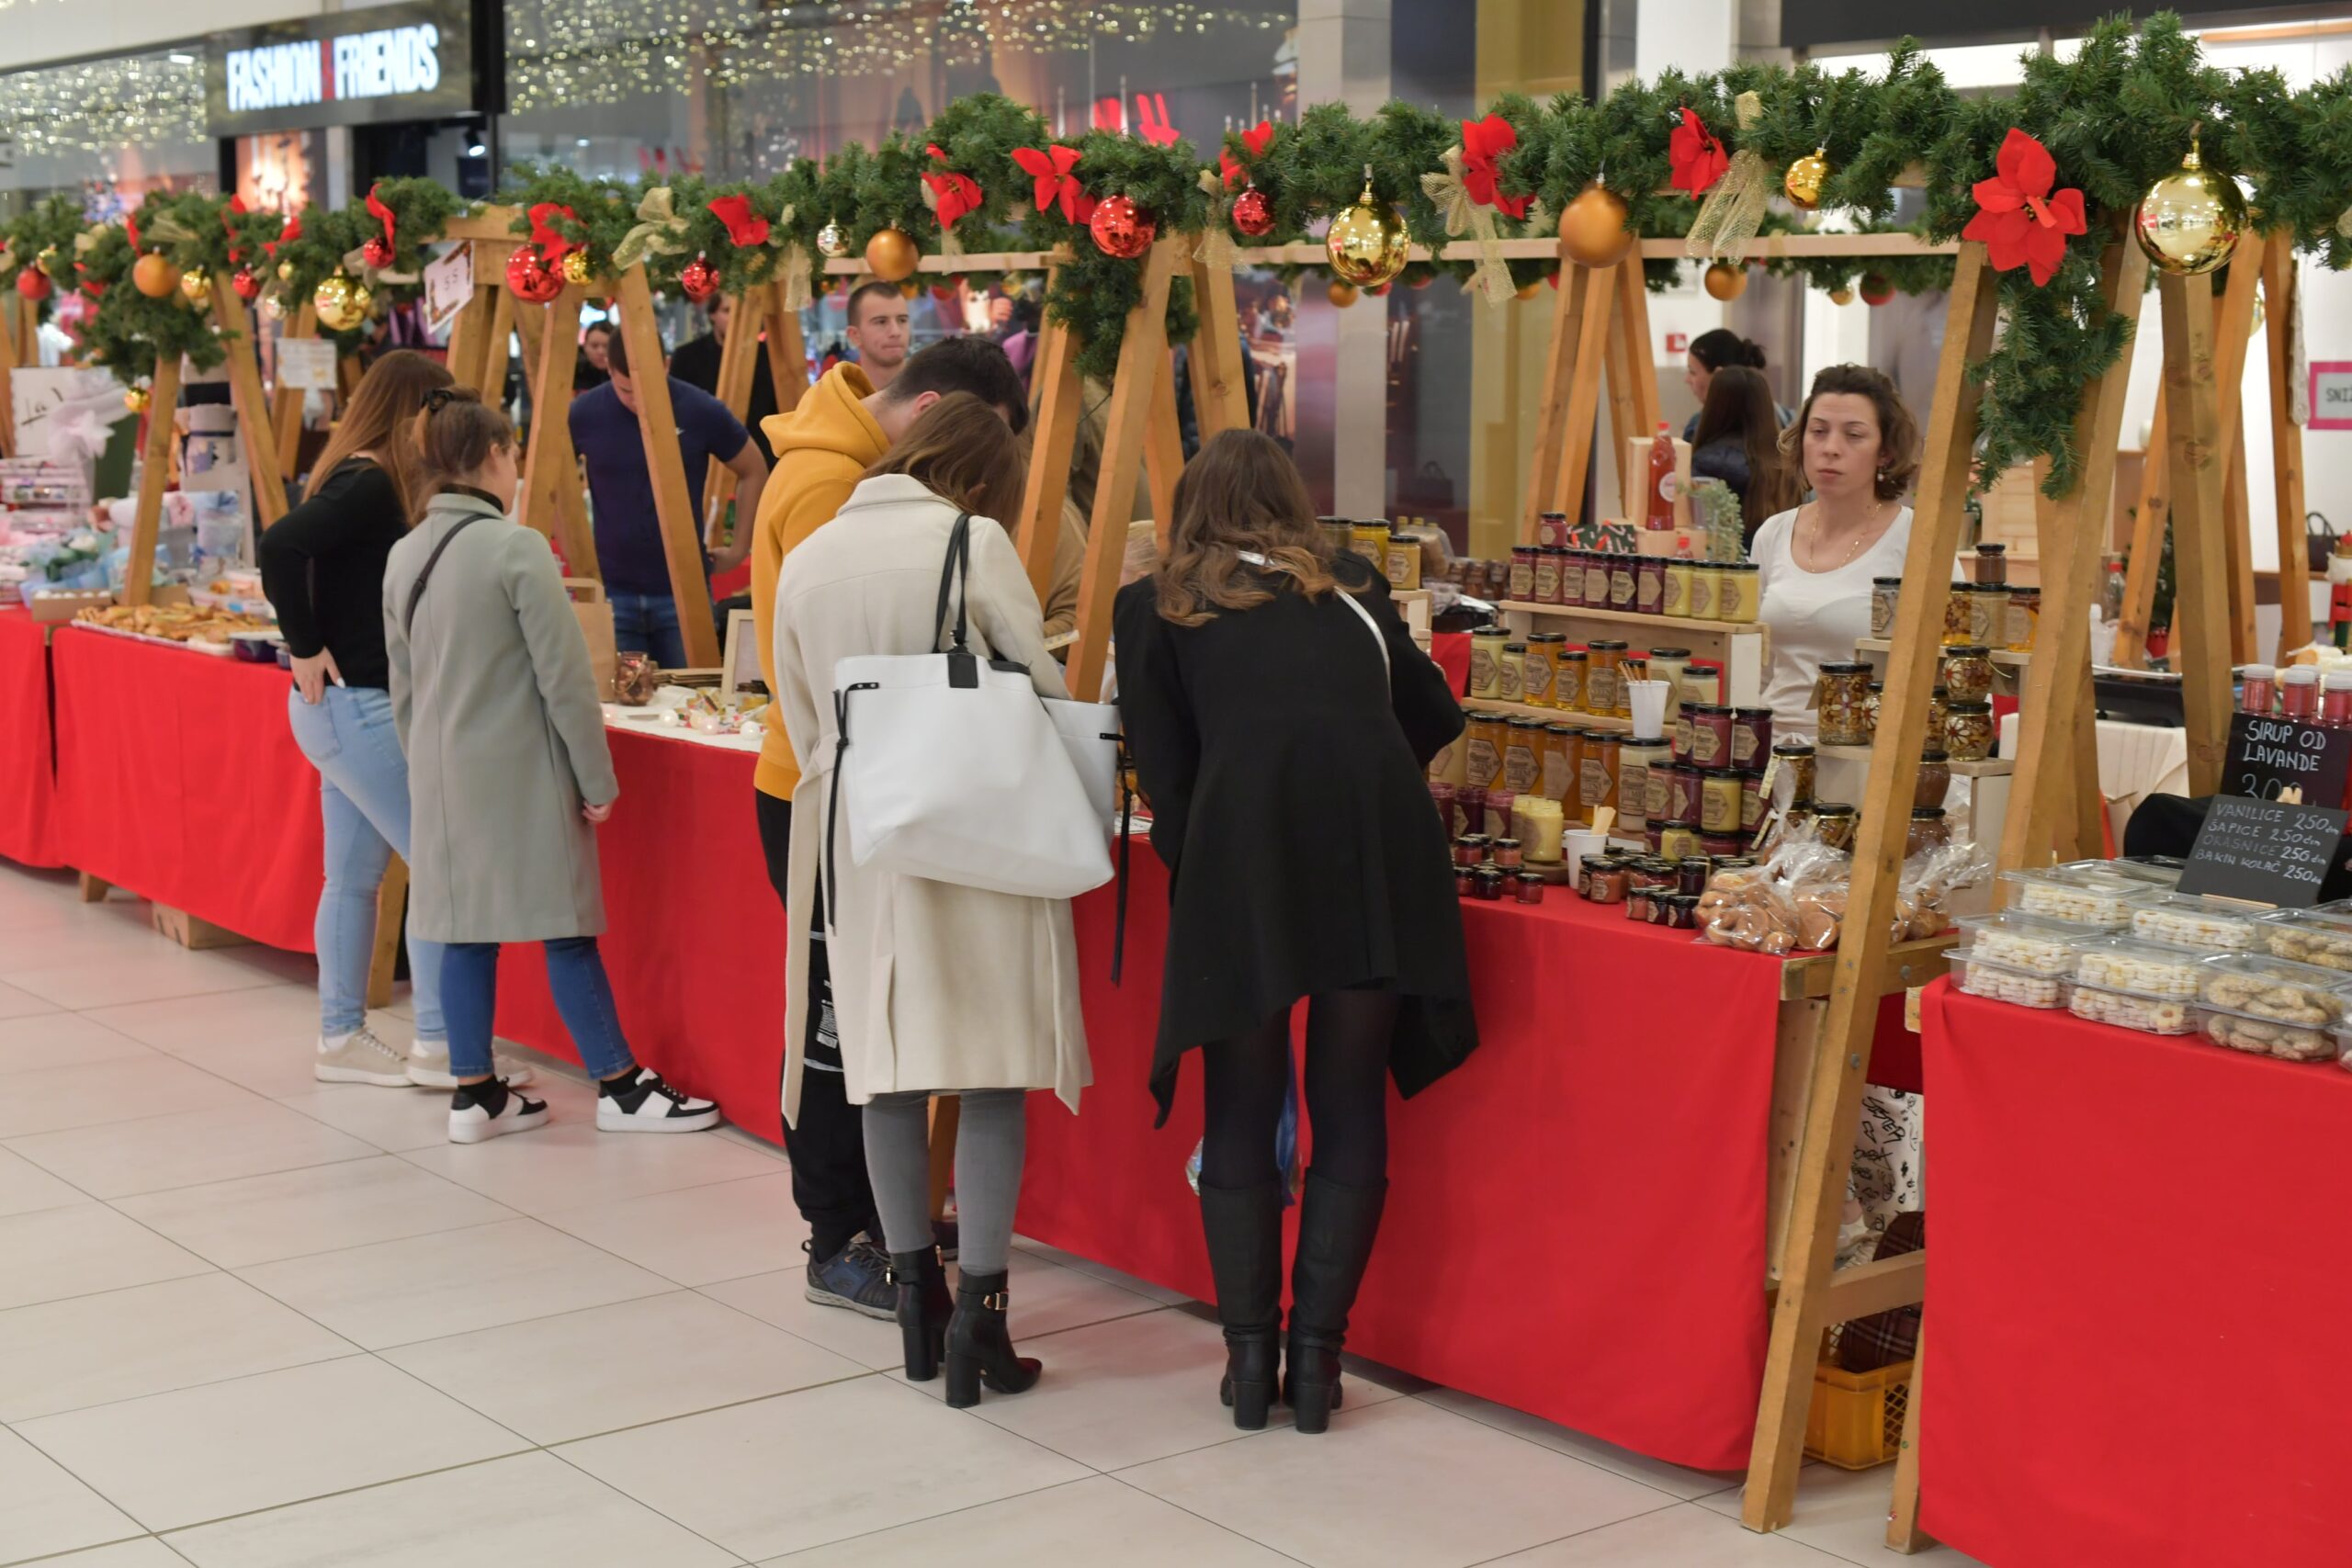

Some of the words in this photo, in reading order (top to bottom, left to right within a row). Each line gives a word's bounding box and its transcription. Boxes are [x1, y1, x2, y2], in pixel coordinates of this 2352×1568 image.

[226, 39, 322, 112] FASHION
[334, 22, 440, 101] FRIENDS
[2245, 719, 2293, 744] SIRUP
[2300, 730, 2326, 750] OD
[2242, 742, 2322, 772] LAVANDE
[2208, 818, 2263, 838] ŠAPICE
[2216, 804, 2285, 823] VANILICE
